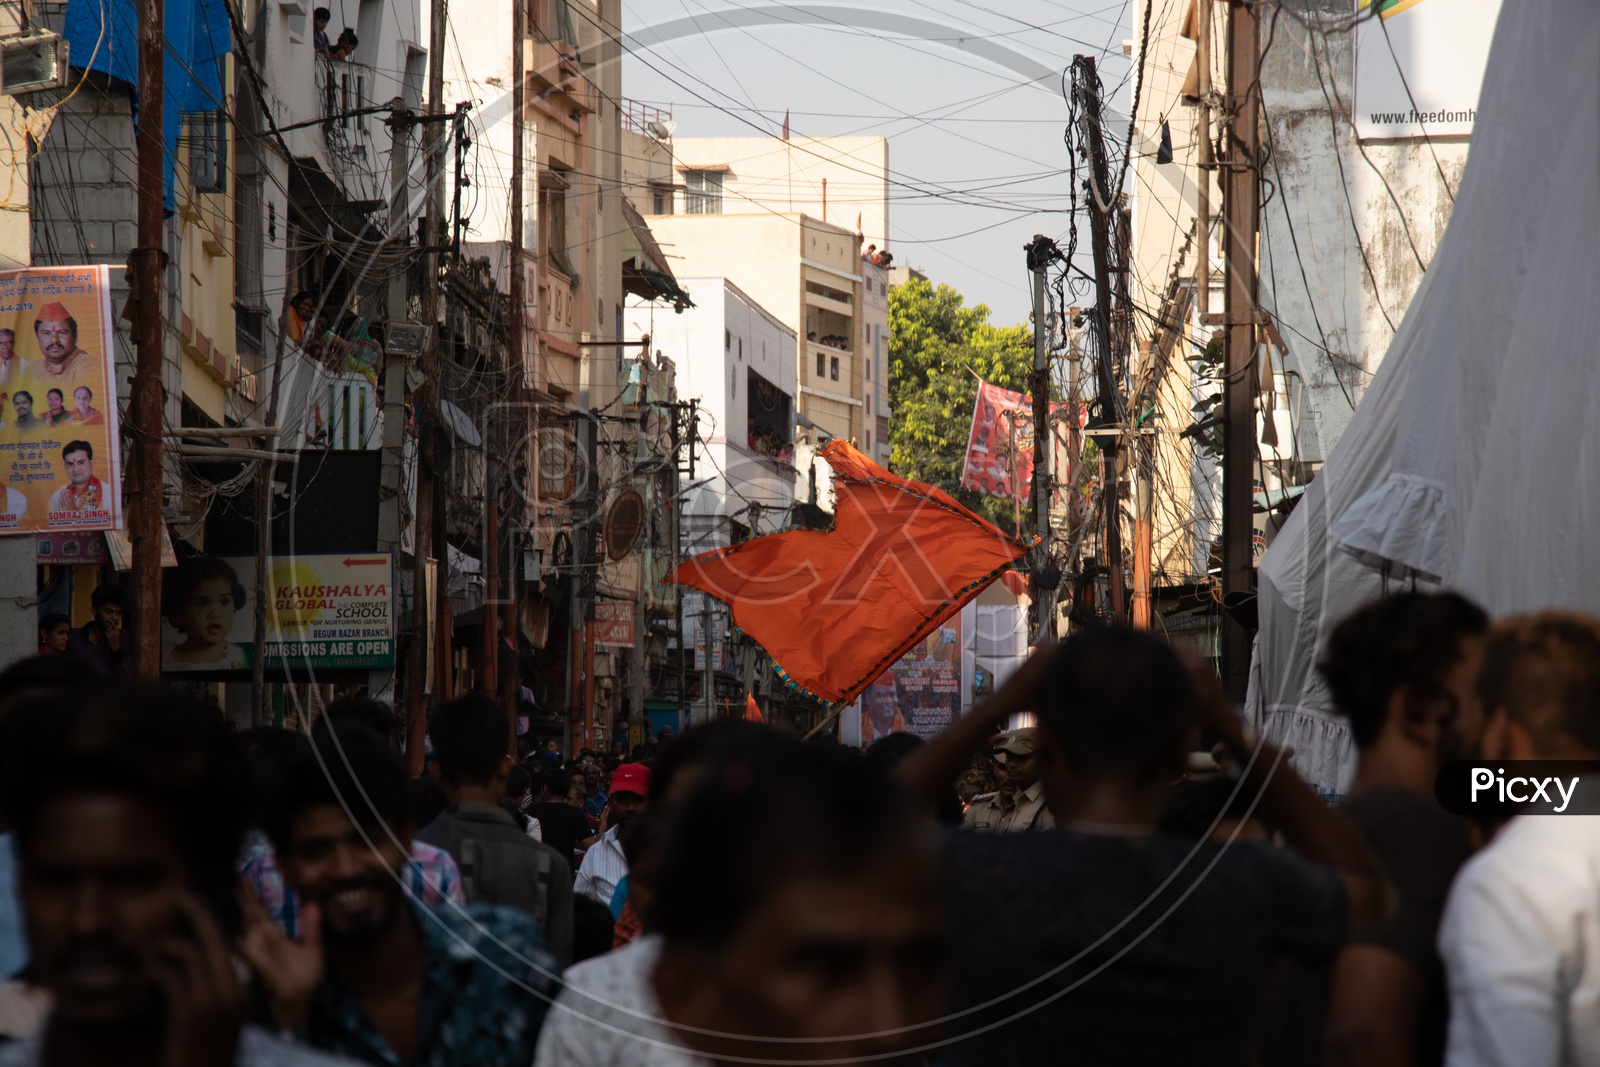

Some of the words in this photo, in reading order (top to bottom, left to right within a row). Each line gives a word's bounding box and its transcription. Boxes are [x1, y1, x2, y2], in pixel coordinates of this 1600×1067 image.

[30, 287, 39, 295] का
[64, 286, 84, 295] स्वागत
[48, 511, 82, 520] SOMRAJ
[84, 510, 109, 518] SINGH
[276, 584, 387, 599] KAUSHALYA
[274, 599, 336, 611] GLOBAL
[350, 601, 388, 609] COMPLETE
[335, 608, 388, 619] SCHOOL
[313, 629, 337, 639] BEGUM
[338, 629, 361, 638] BAZAR
[362, 628, 390, 638] BRANCH
[263, 643, 327, 657] DMISSIONS
[329, 642, 354, 656] ARE
[357, 641, 390, 655] OPEN
